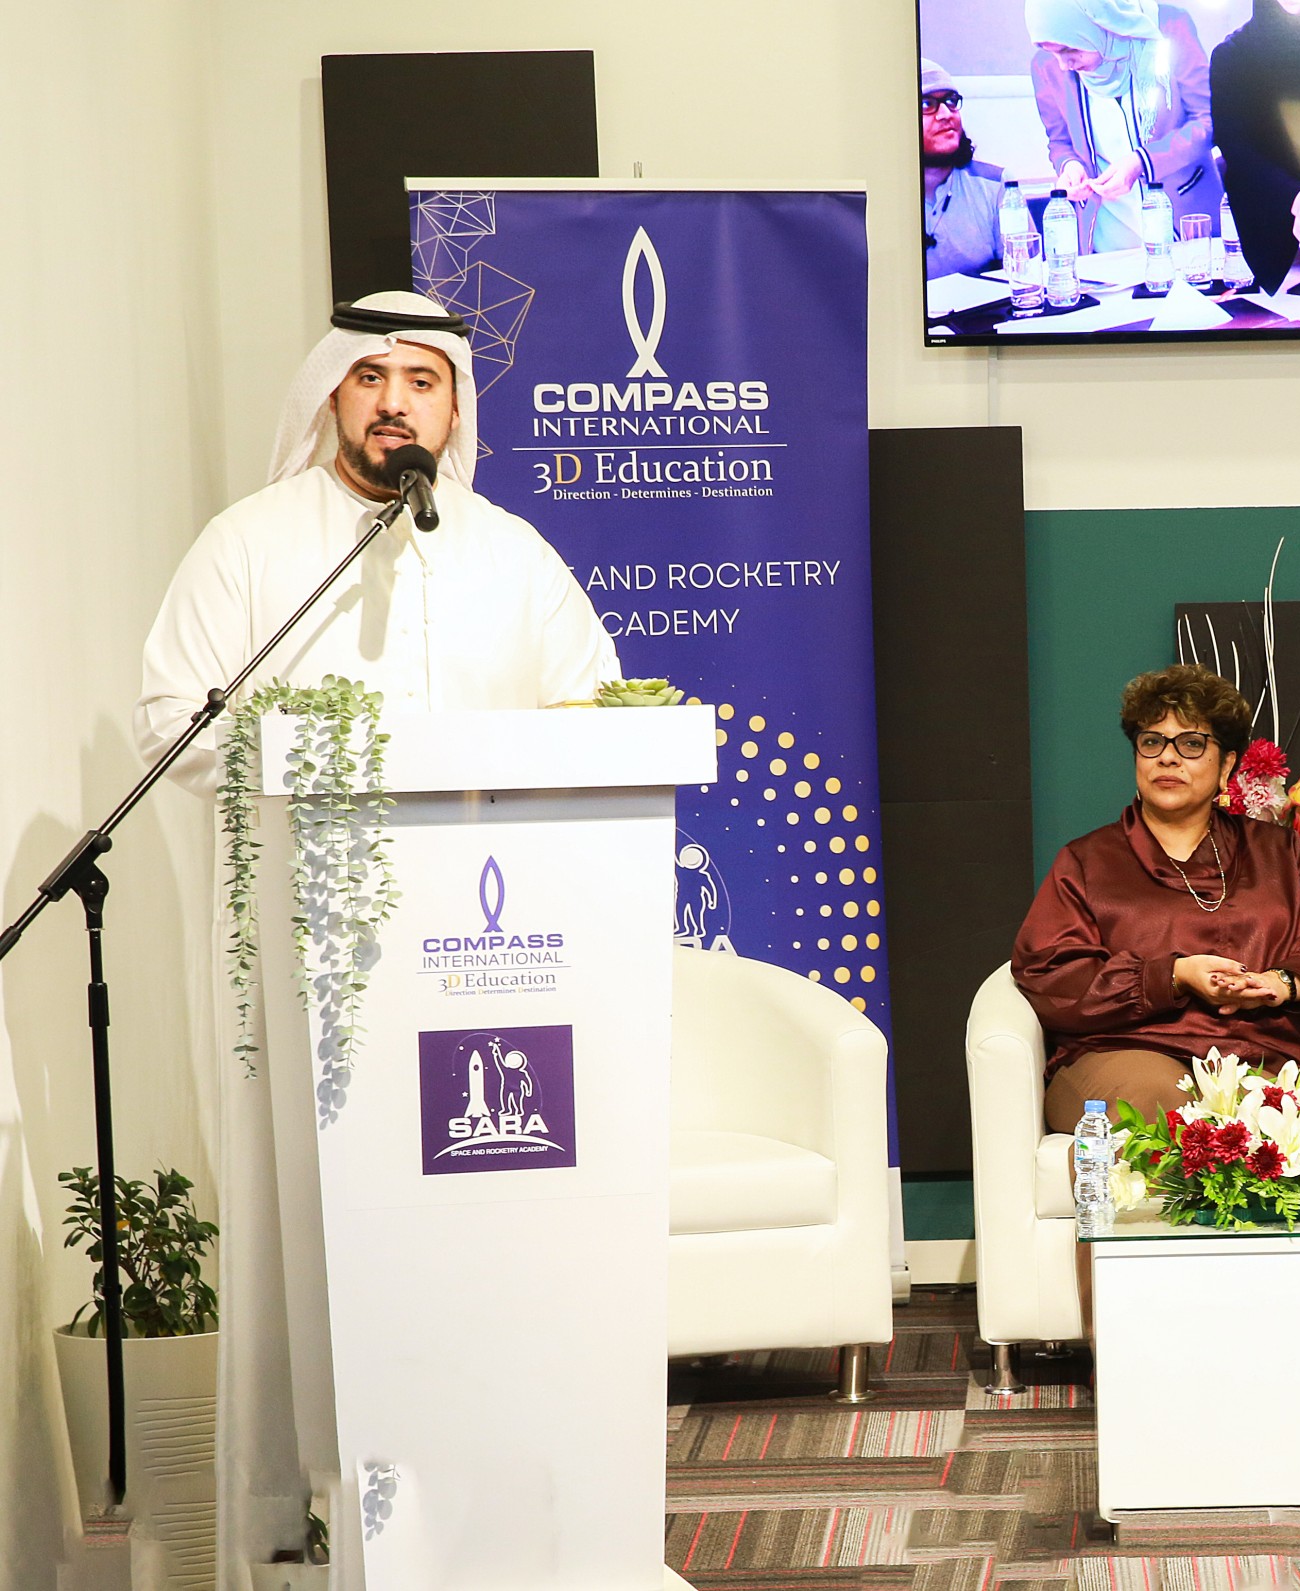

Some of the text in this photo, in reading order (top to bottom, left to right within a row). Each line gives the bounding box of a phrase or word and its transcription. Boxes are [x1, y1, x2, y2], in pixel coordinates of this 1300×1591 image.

[533, 381, 769, 413] COMPASS
[533, 415, 770, 437] INTERNATIONAL
[533, 450, 773, 494] 3D Education
[553, 489, 611, 500] Direction
[621, 488, 692, 499] Determines
[702, 486, 773, 498] Destination
[586, 560, 840, 591] AND ROCKETRY
[599, 608, 740, 637] CADEMY
[423, 933, 564, 953] COMPASS
[423, 952, 563, 968] INTERNATIONAL
[438, 971, 556, 993] 3D Education
[448, 1114, 550, 1139] SARA
[486, 1147, 518, 1155] ROCKETRY
